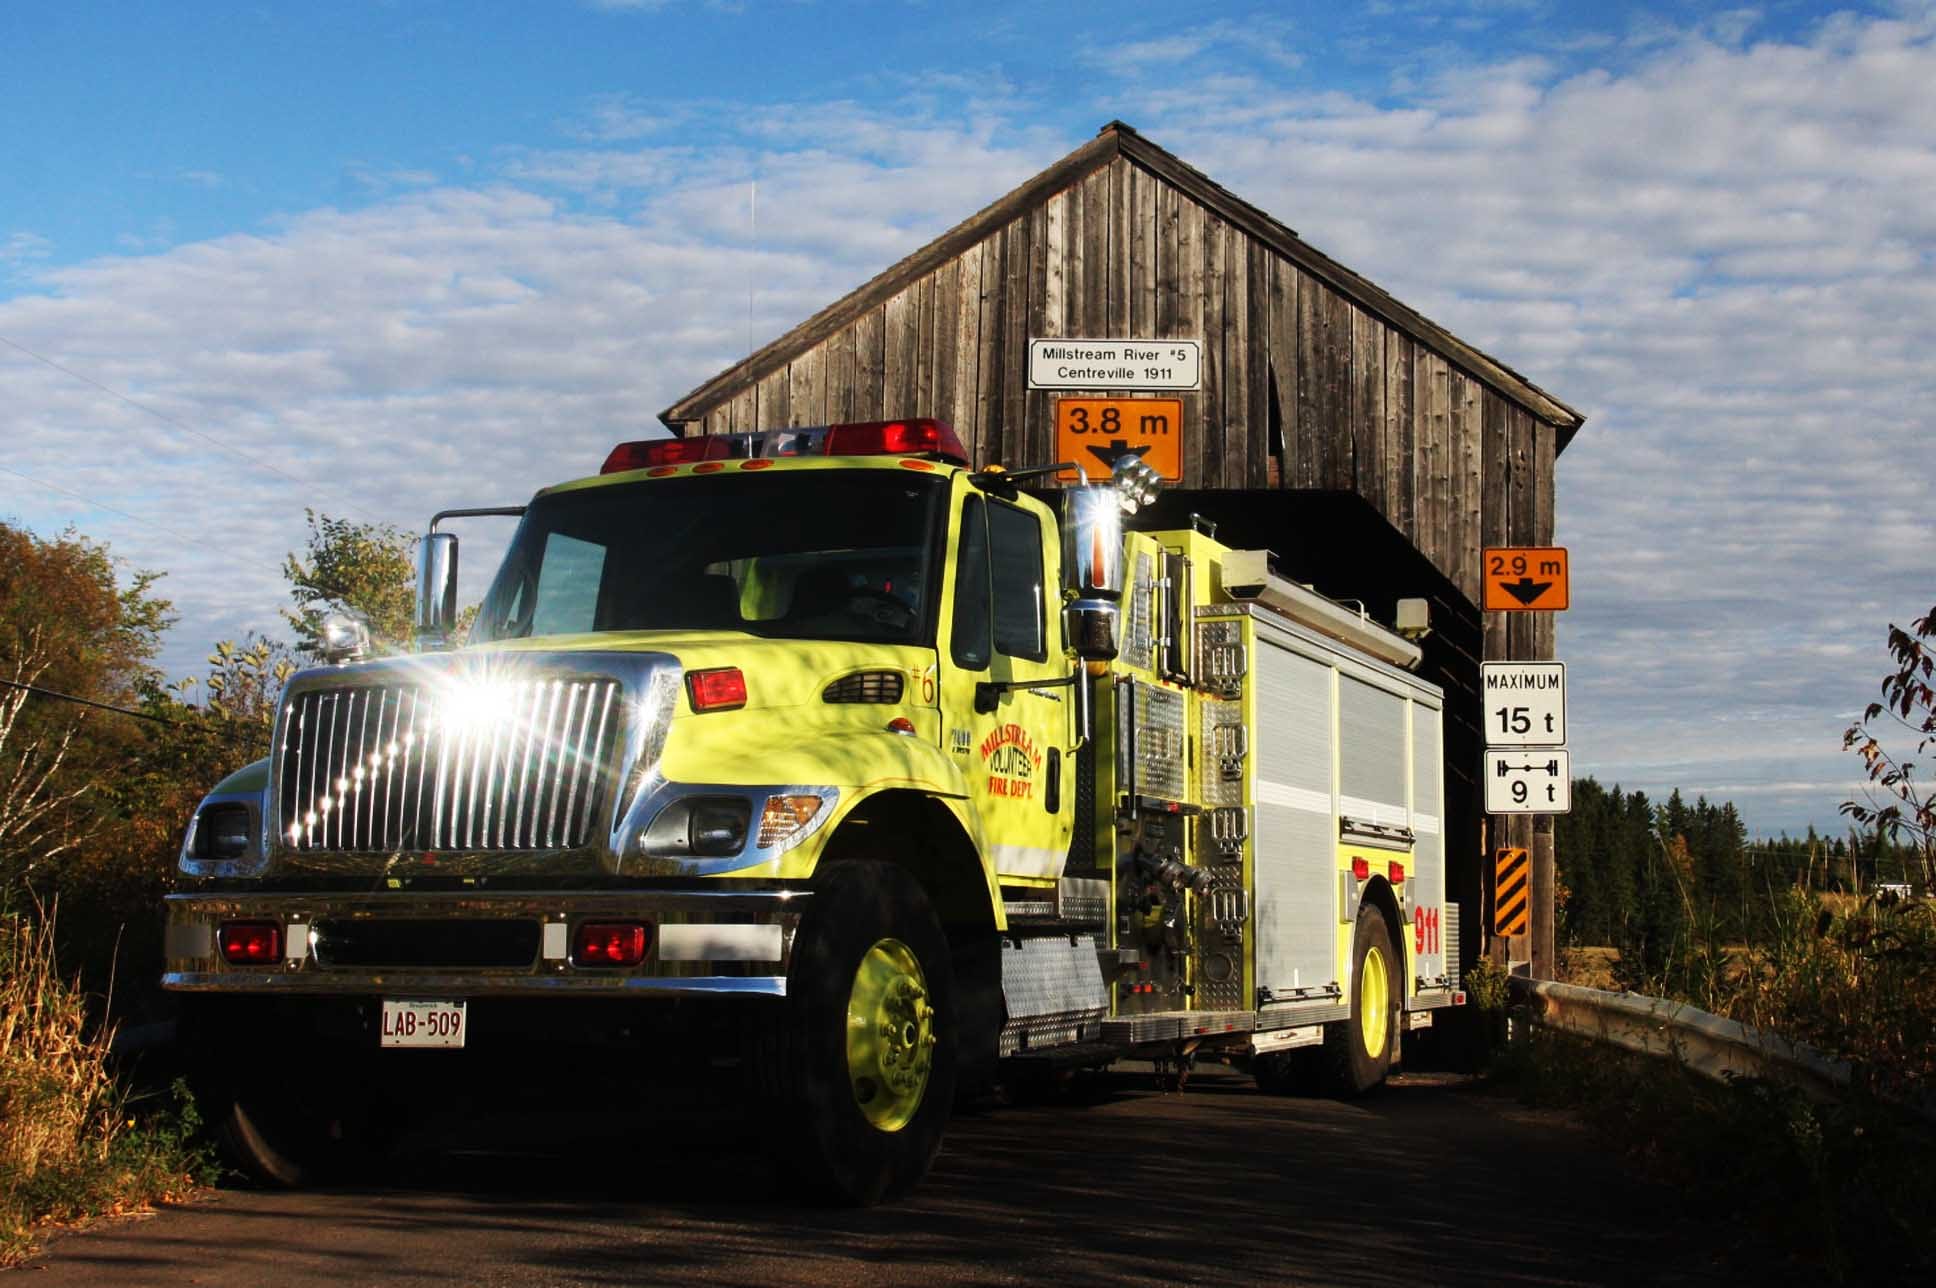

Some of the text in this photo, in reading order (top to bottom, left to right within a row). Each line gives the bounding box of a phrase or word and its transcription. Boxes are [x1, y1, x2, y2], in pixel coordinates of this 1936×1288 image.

[1042, 347, 1116, 361] Millstream
[1124, 348, 1160, 361] River
[1057, 366, 1173, 380] Centreville 1911
[1069, 407, 1168, 435] 3.8 m
[1490, 556, 1561, 577] 2.9 m
[912, 664, 934, 704] #6
[1487, 674, 1559, 690] MAXIMUM
[1495, 707, 1554, 734] 15 t
[981, 723, 1041, 773] MILLSTREAM
[989, 776, 1008, 795] FIRE
[1511, 780, 1556, 804] 9 t
[1415, 905, 1439, 955] 911
[383, 1011, 461, 1037] LAB-509
